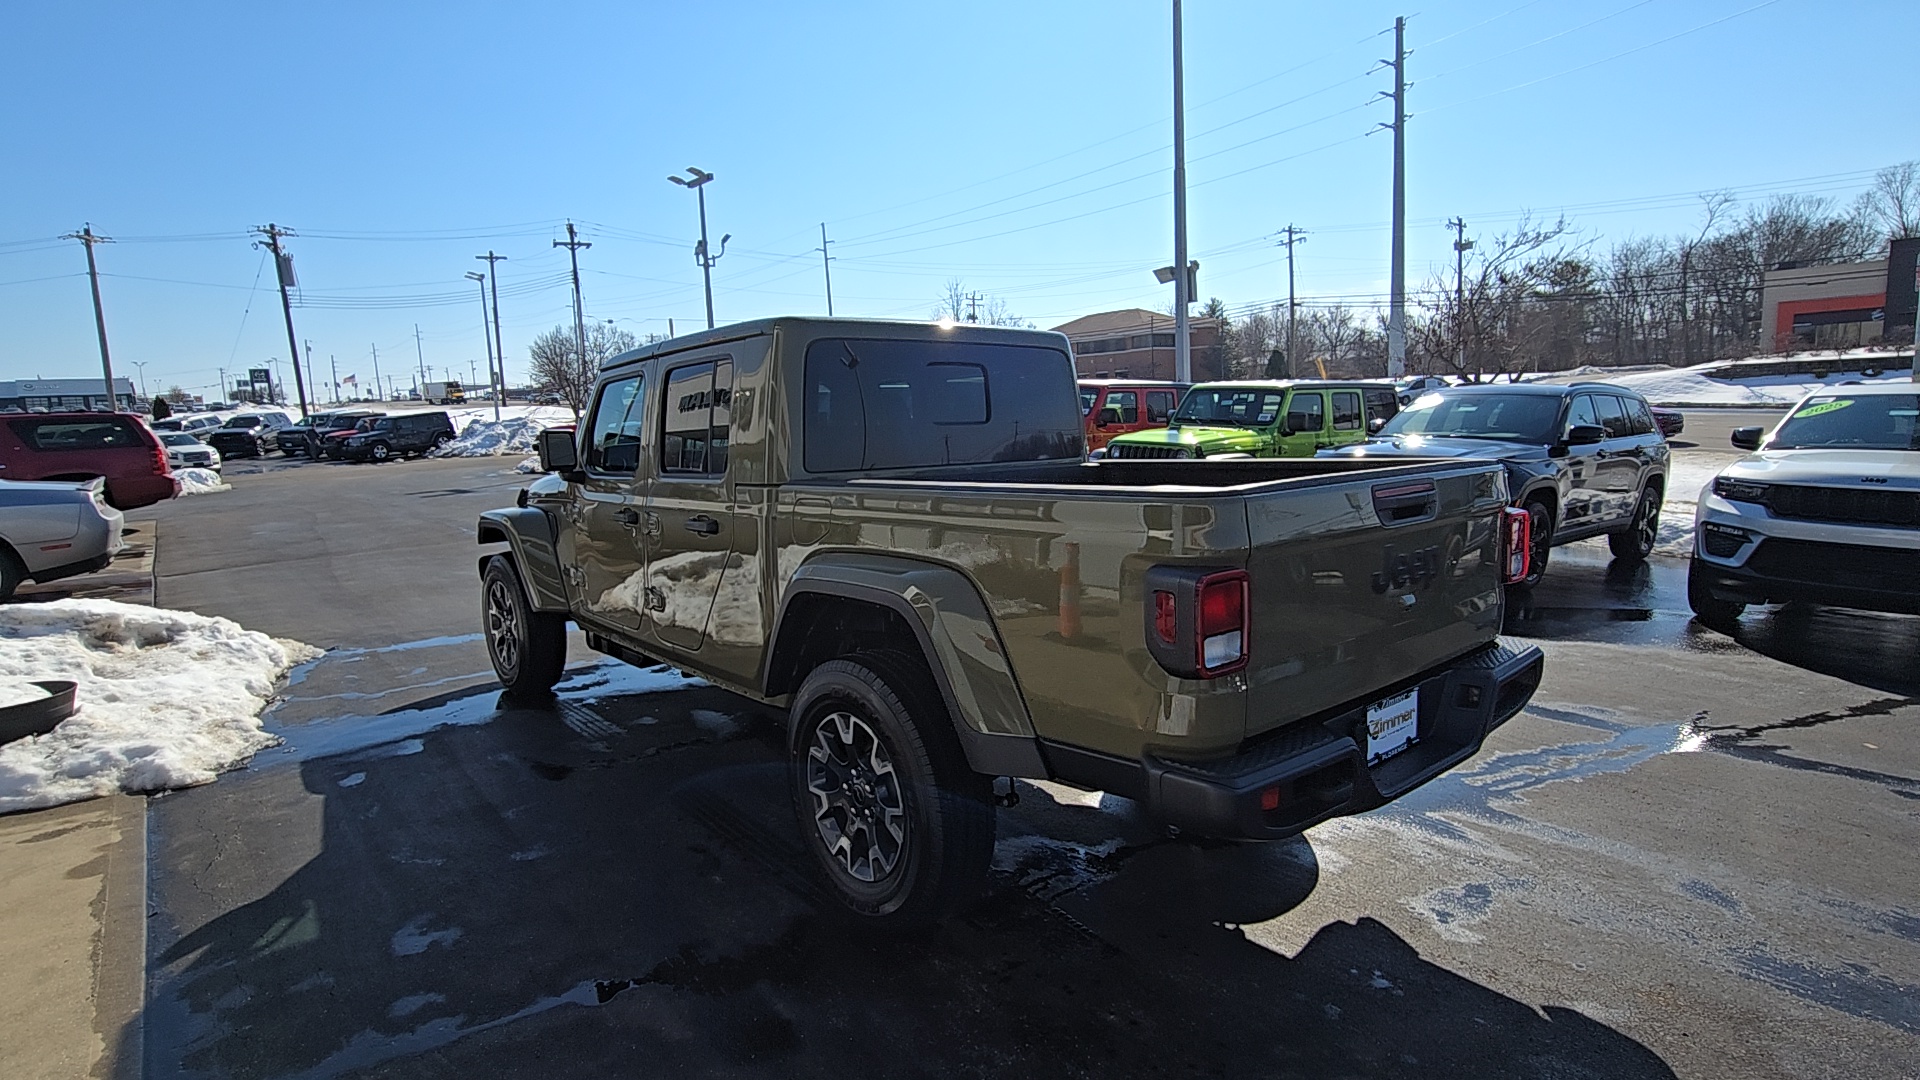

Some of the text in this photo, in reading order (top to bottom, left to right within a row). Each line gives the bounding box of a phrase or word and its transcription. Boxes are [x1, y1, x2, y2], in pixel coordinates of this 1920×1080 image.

[1805, 402, 1843, 416] 2025
[1861, 476, 1888, 485] Jeep
[1381, 693, 1408, 710] Zimmer
[1370, 708, 1415, 737] Zimmer
